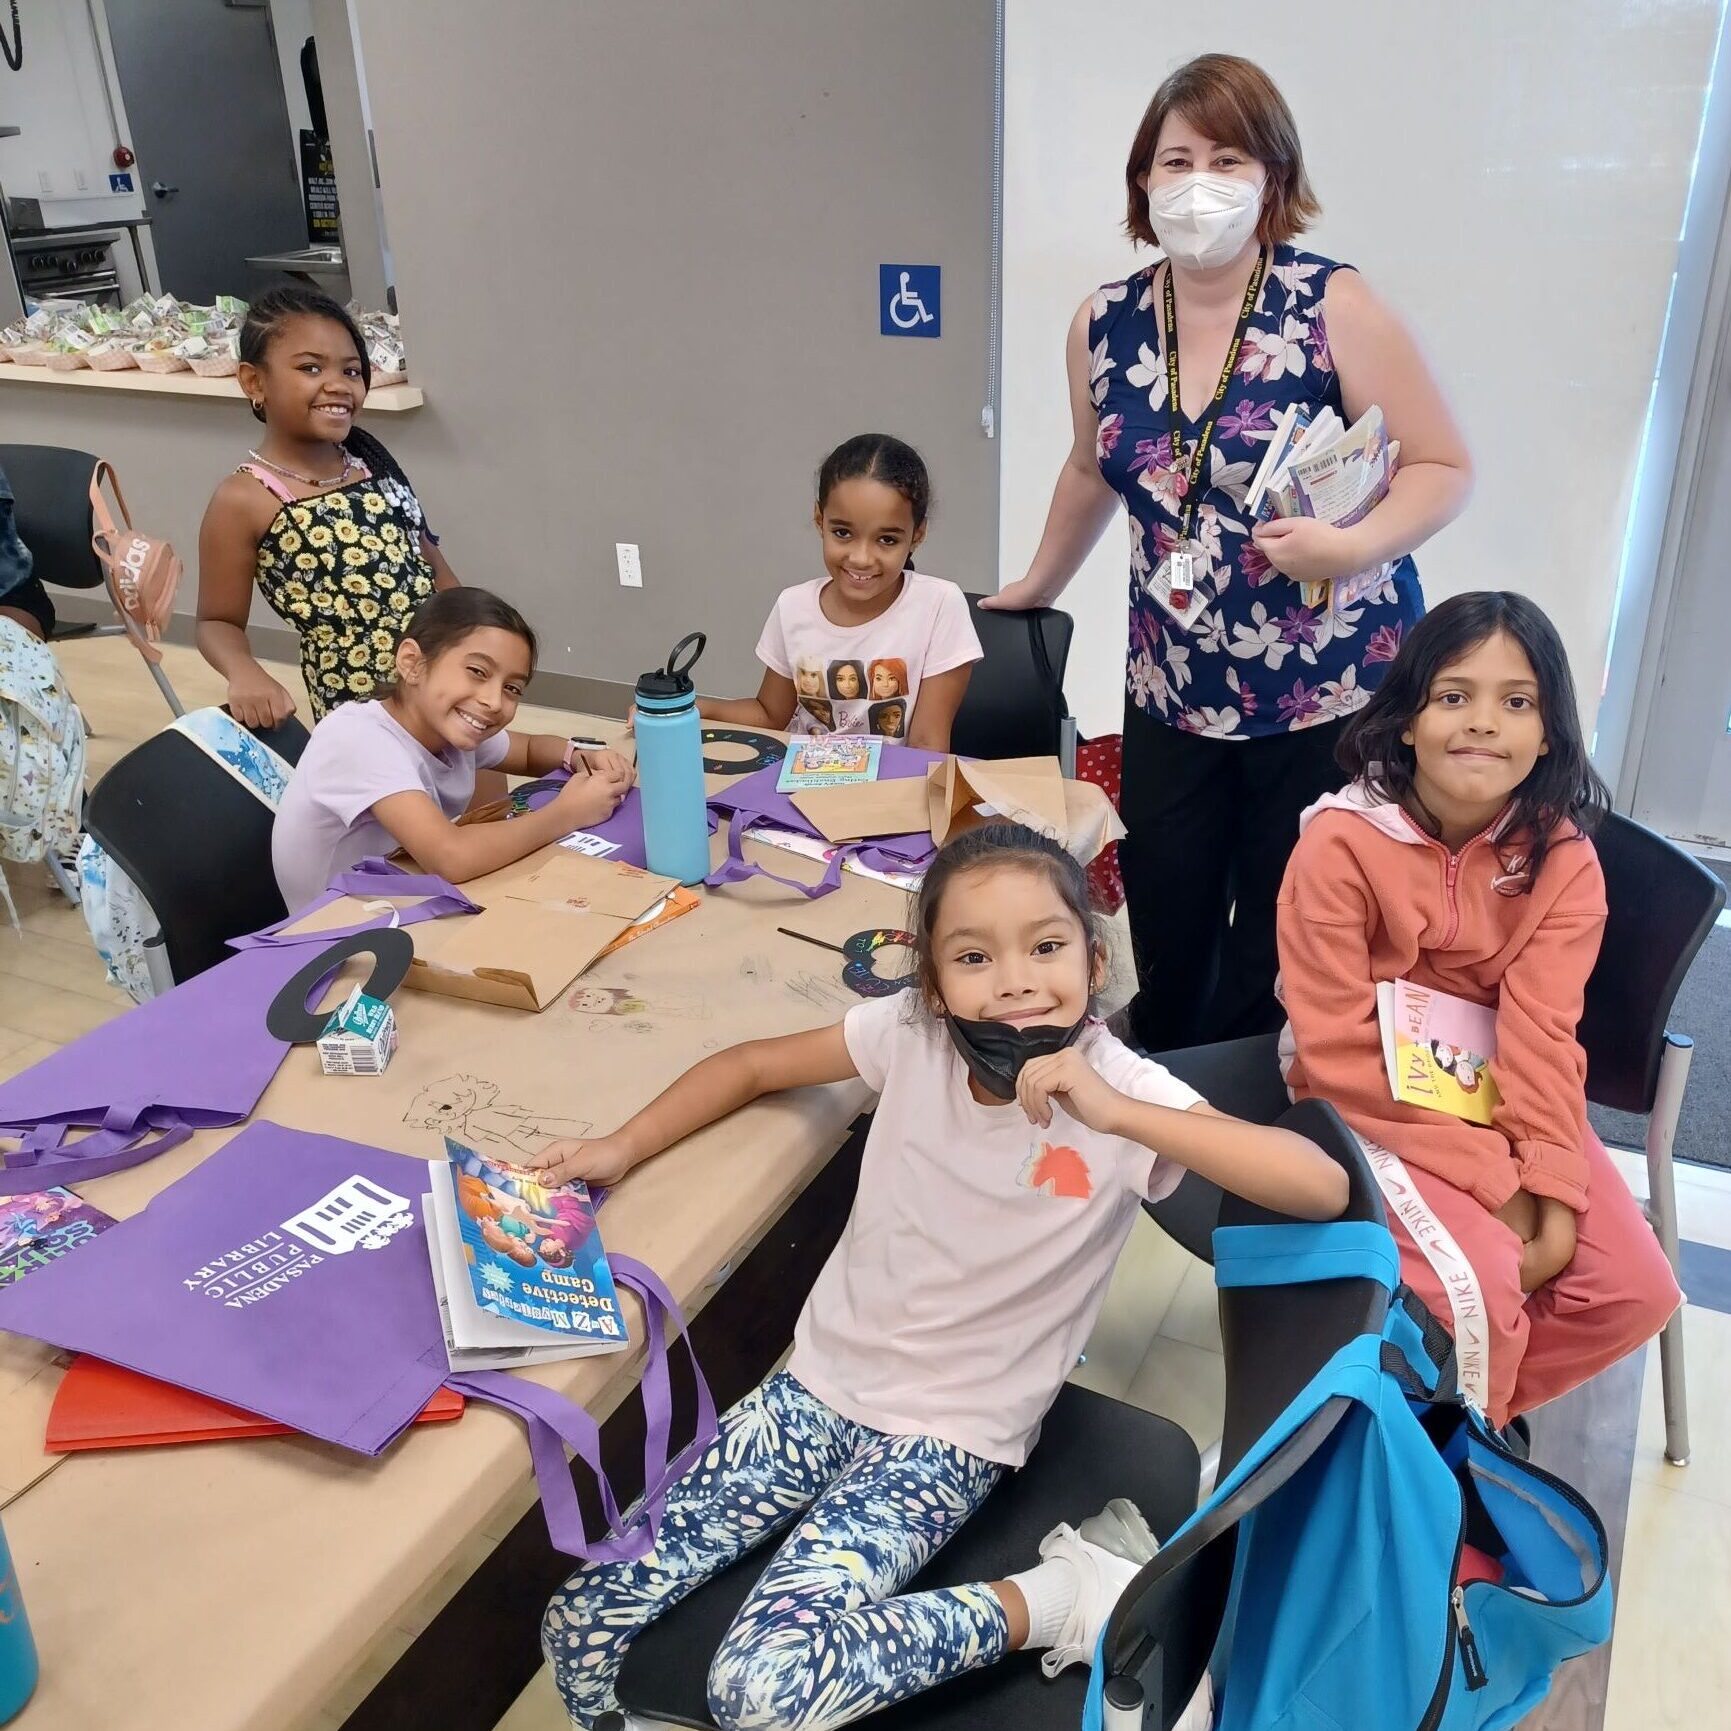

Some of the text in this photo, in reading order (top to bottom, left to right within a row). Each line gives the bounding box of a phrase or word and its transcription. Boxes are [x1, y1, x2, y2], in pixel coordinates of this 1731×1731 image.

[1241, 257, 1263, 319] City of Pasadena
[1168, 351, 1177, 368] City
[1215, 382, 1227, 400] City
[1224, 338, 1240, 373] Pasadena
[1170, 376, 1179, 412] Pasadena
[1172, 430, 1180, 447] City
[1190, 466, 1200, 484] City
[1196, 421, 1213, 459] Pasadena
[1404, 986, 1430, 1033] BEAN
[1400, 1198, 1437, 1237] NIKE
[182, 1231, 282, 1291] LIBRARY
[204, 1244, 303, 1298] PUBLIC
[224, 1253, 325, 1309] PASADENA
[541, 1270, 595, 1293] Camp
[522, 1282, 615, 1312] Detective
[1449, 1271, 1480, 1319] NIKE
[601, 1316, 619, 1335] A
[1463, 1350, 1481, 1385] NIKE
